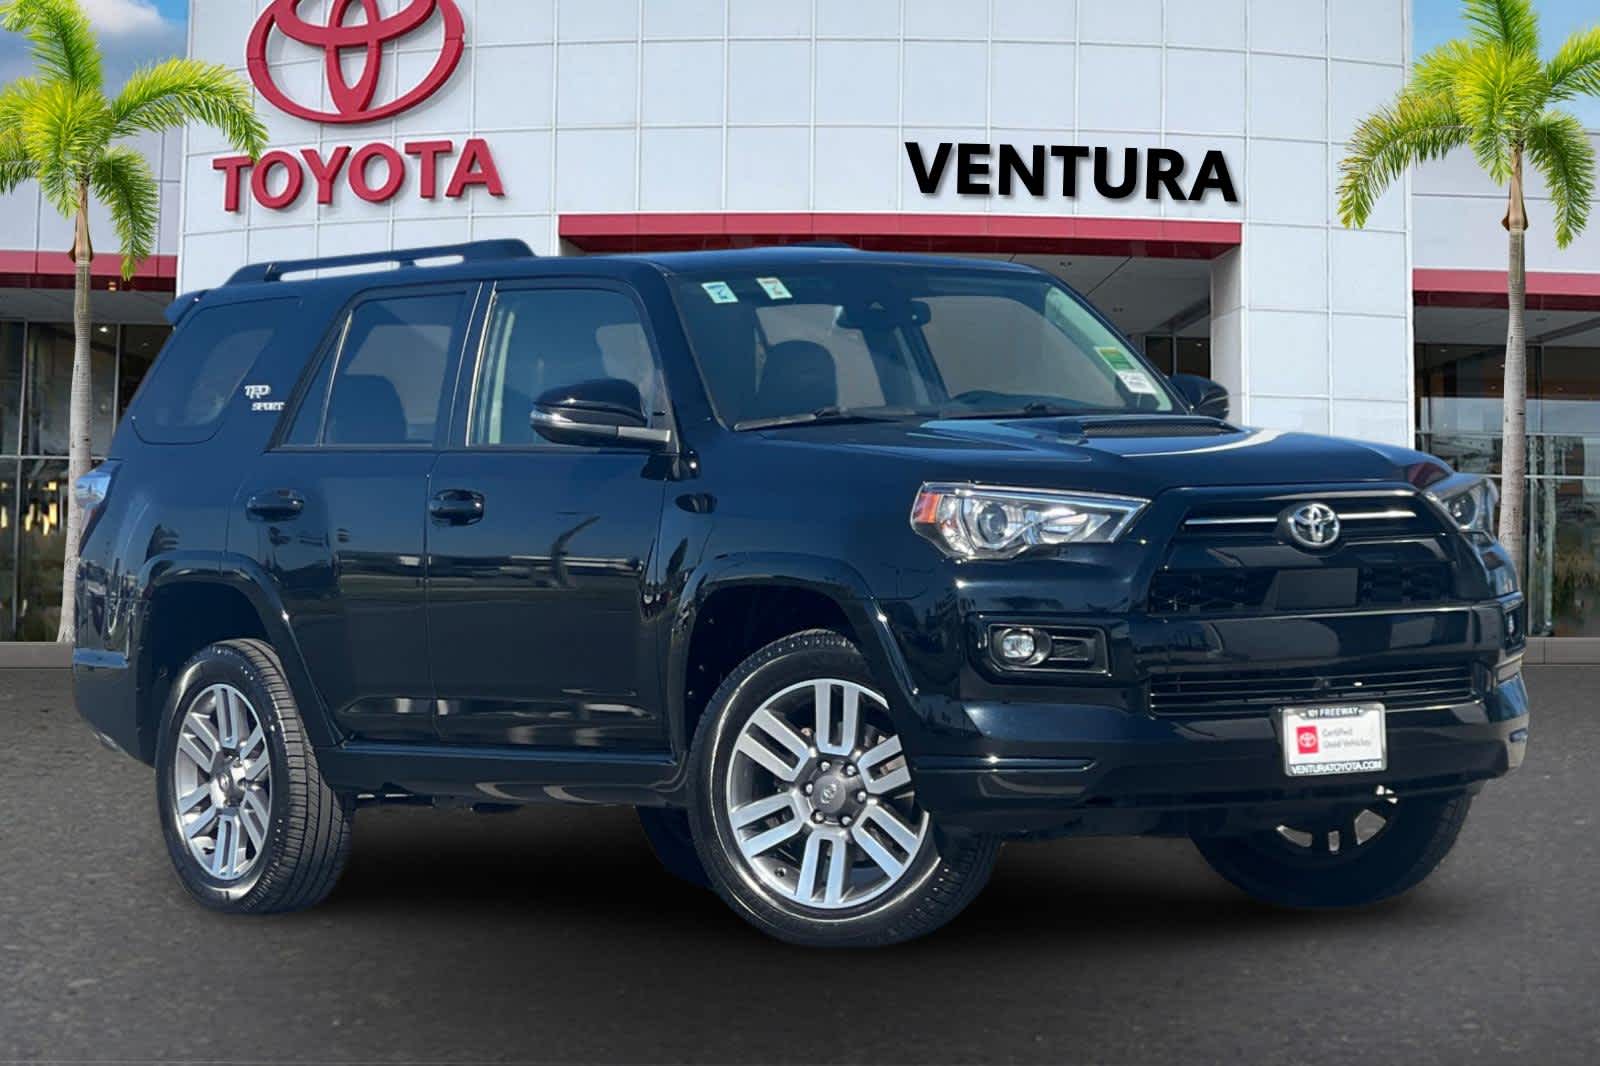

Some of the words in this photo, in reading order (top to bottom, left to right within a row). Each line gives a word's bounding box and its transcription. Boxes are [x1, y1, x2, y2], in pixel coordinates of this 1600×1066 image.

[212, 138, 505, 213] TOYOTA
[904, 142, 1239, 203] VENTURA
[244, 384, 271, 399] TRD
[252, 401, 285, 411] SPORT
[1320, 706, 1359, 717] FREEWAY
